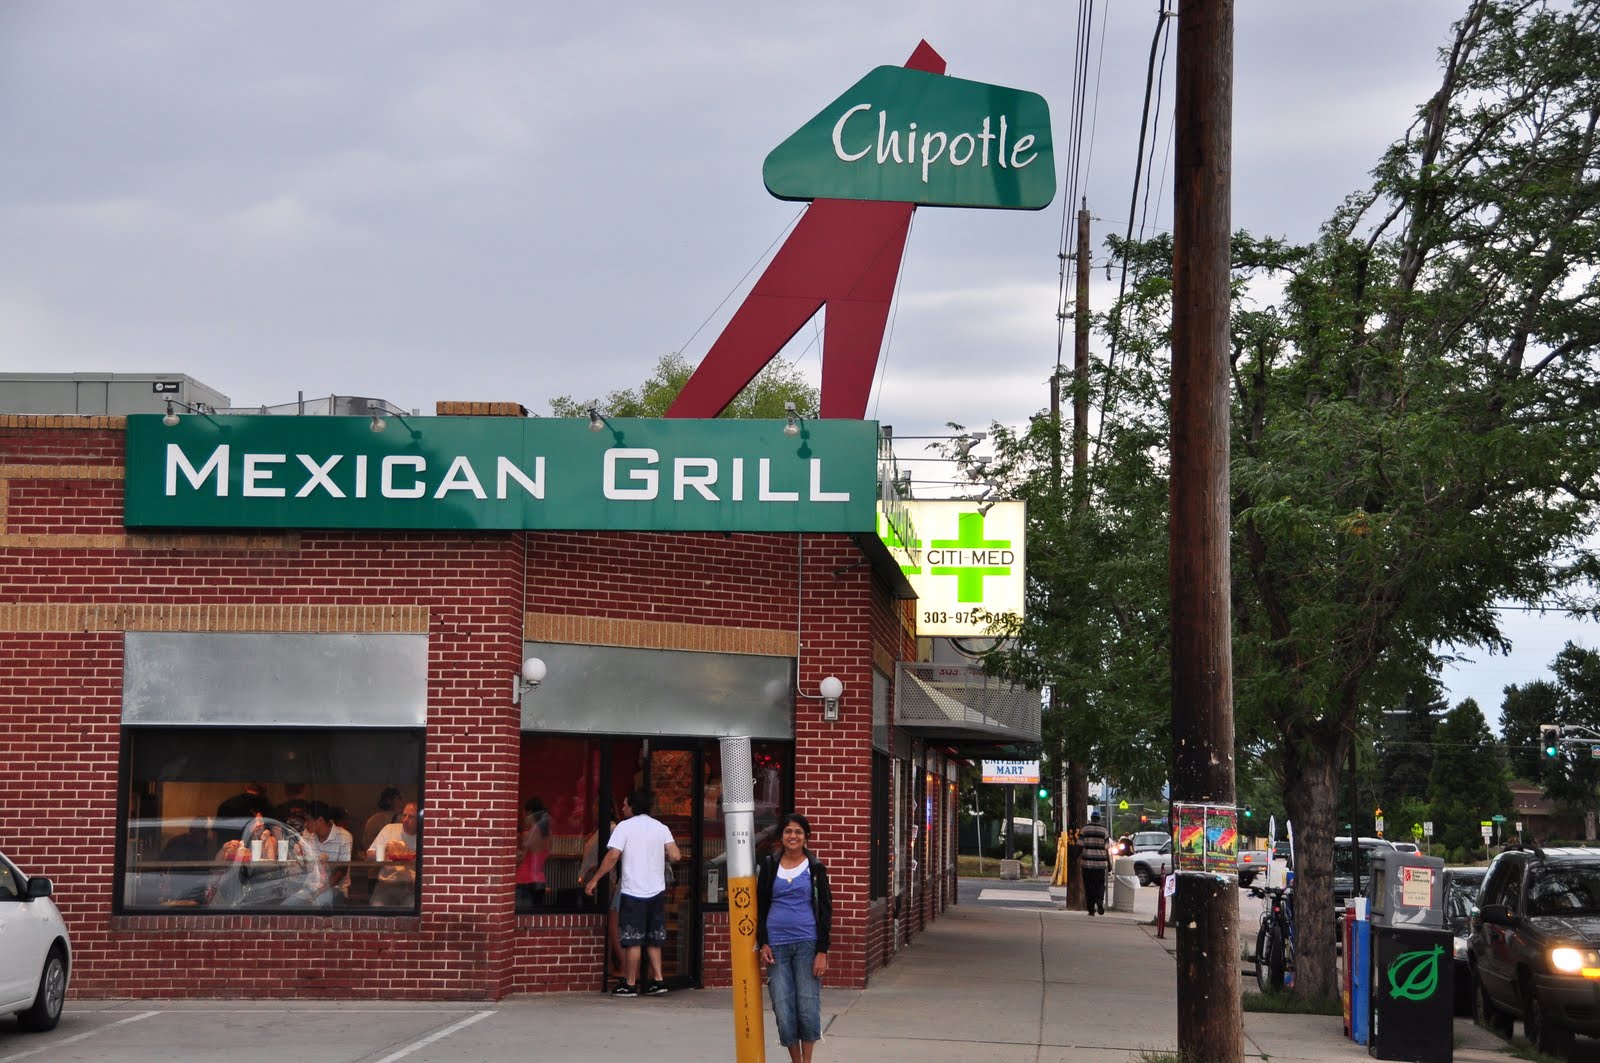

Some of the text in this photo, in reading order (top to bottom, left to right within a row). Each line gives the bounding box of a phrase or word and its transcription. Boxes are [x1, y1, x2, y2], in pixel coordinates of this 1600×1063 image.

[832, 103, 1038, 184] Chipotle
[165, 443, 851, 502] MEXICAN GRILL
[926, 550, 1015, 565] CITI-MED
[996, 765, 1025, 775] MART
